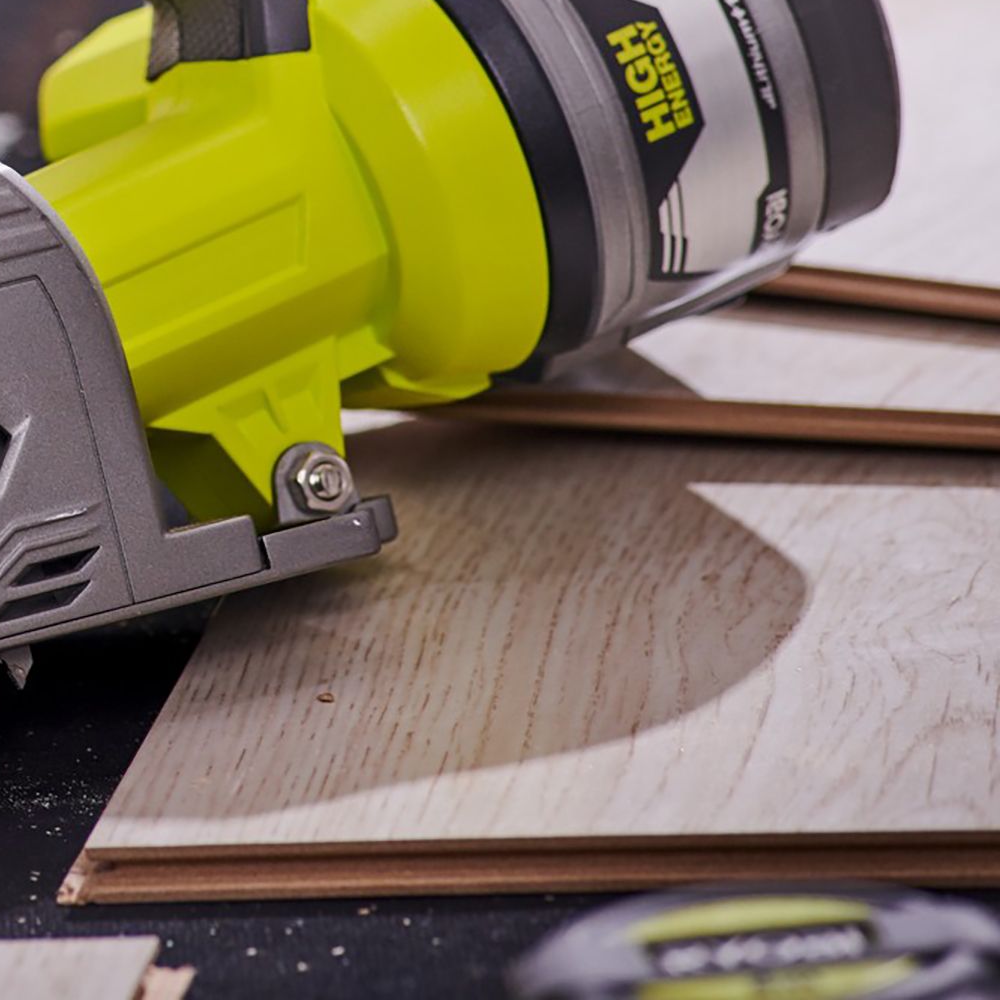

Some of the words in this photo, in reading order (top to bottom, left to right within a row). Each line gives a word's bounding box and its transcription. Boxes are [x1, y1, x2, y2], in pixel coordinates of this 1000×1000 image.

[606, 23, 677, 143] HIGH
[634, 21, 694, 129] ENERGY
[762, 188, 788, 240] OBI
